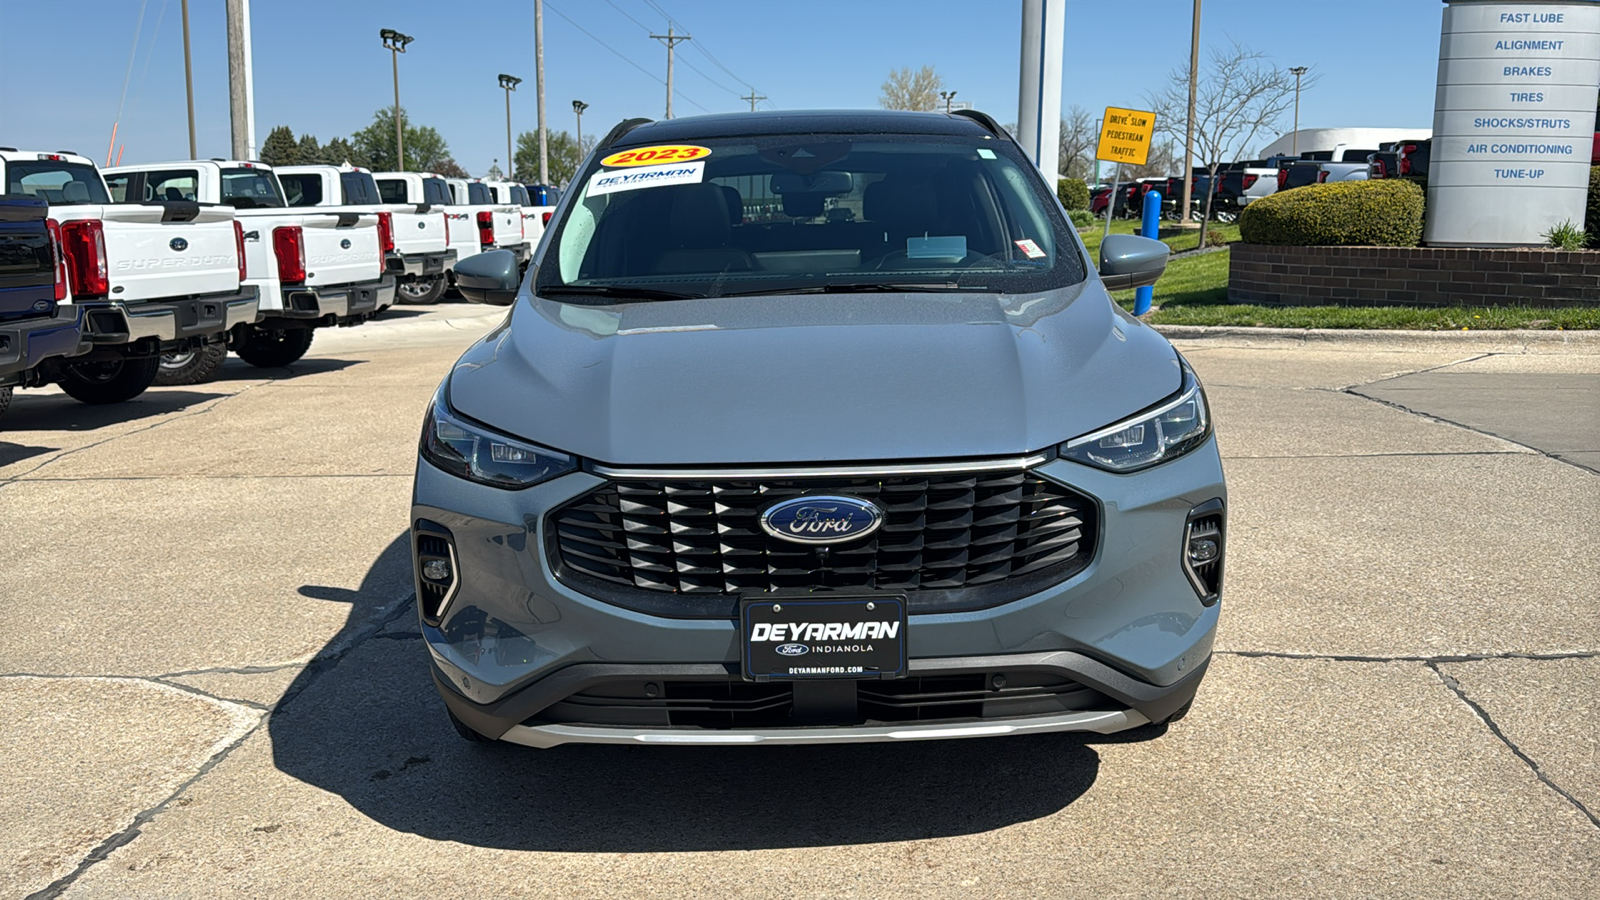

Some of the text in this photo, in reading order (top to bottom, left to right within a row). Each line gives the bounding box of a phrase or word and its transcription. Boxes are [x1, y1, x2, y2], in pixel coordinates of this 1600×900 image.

[1500, 13, 1564, 23] FAST LUBE
[1495, 40, 1564, 51] ALIGNMENT
[1503, 66, 1552, 77] BRAKES
[1510, 92, 1544, 103] TIRES
[1110, 115, 1147, 127] DRIVE SLOW
[1474, 118, 1571, 129] SHOCKS/STRUTS
[1107, 130, 1143, 142] PEDESTRIAN
[1111, 146, 1136, 157] TRAFFIC
[1467, 144, 1573, 155] AIR CONDITIONING
[611, 148, 701, 165] 2023
[597, 168, 697, 186] DEYARMAN
[1494, 169, 1545, 179] TUNE-UP
[117, 255, 234, 271] SUPER DUTY
[790, 507, 854, 533] Ford
[750, 621, 900, 642] DEYARMAN
[782, 645, 874, 654] Ford INDIANOLA
[788, 666, 863, 675] DEYARMANFORD.COM
